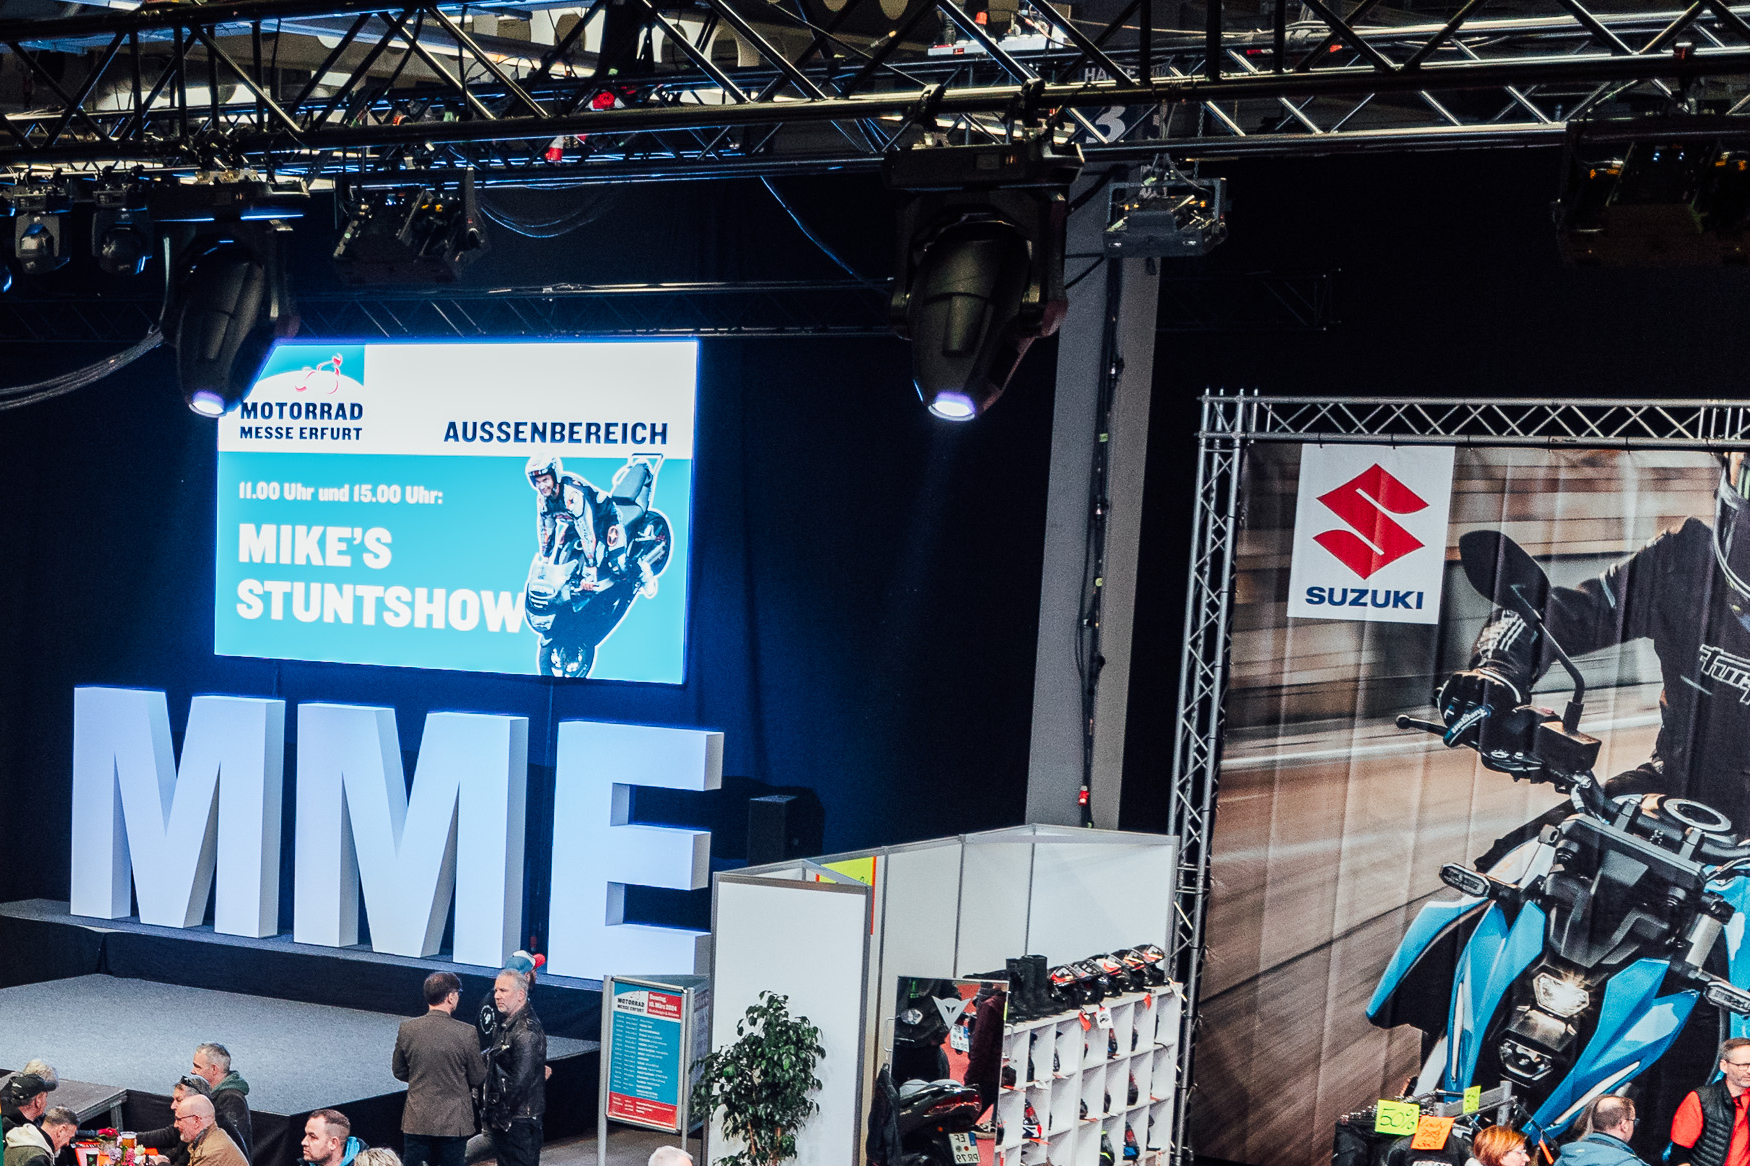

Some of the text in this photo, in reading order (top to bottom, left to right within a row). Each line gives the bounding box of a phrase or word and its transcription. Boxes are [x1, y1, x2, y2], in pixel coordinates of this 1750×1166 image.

[1084, 66, 1137, 81] HAE
[239, 401, 364, 421] MOTORRAD
[239, 425, 363, 442] MESSE ERFURT
[443, 420, 669, 446] AUSSENBEREICH
[239, 481, 444, 505] 11.00 Uhr und 15.00 Uhr:
[238, 523, 393, 570] MIKE'S
[235, 578, 527, 634] STUNTSHOW
[1305, 585, 1424, 611] SUZUKI
[70, 685, 724, 977] MME
[617, 997, 645, 1008] MOTORRAD
[1379, 1107, 1415, 1130] 50%
